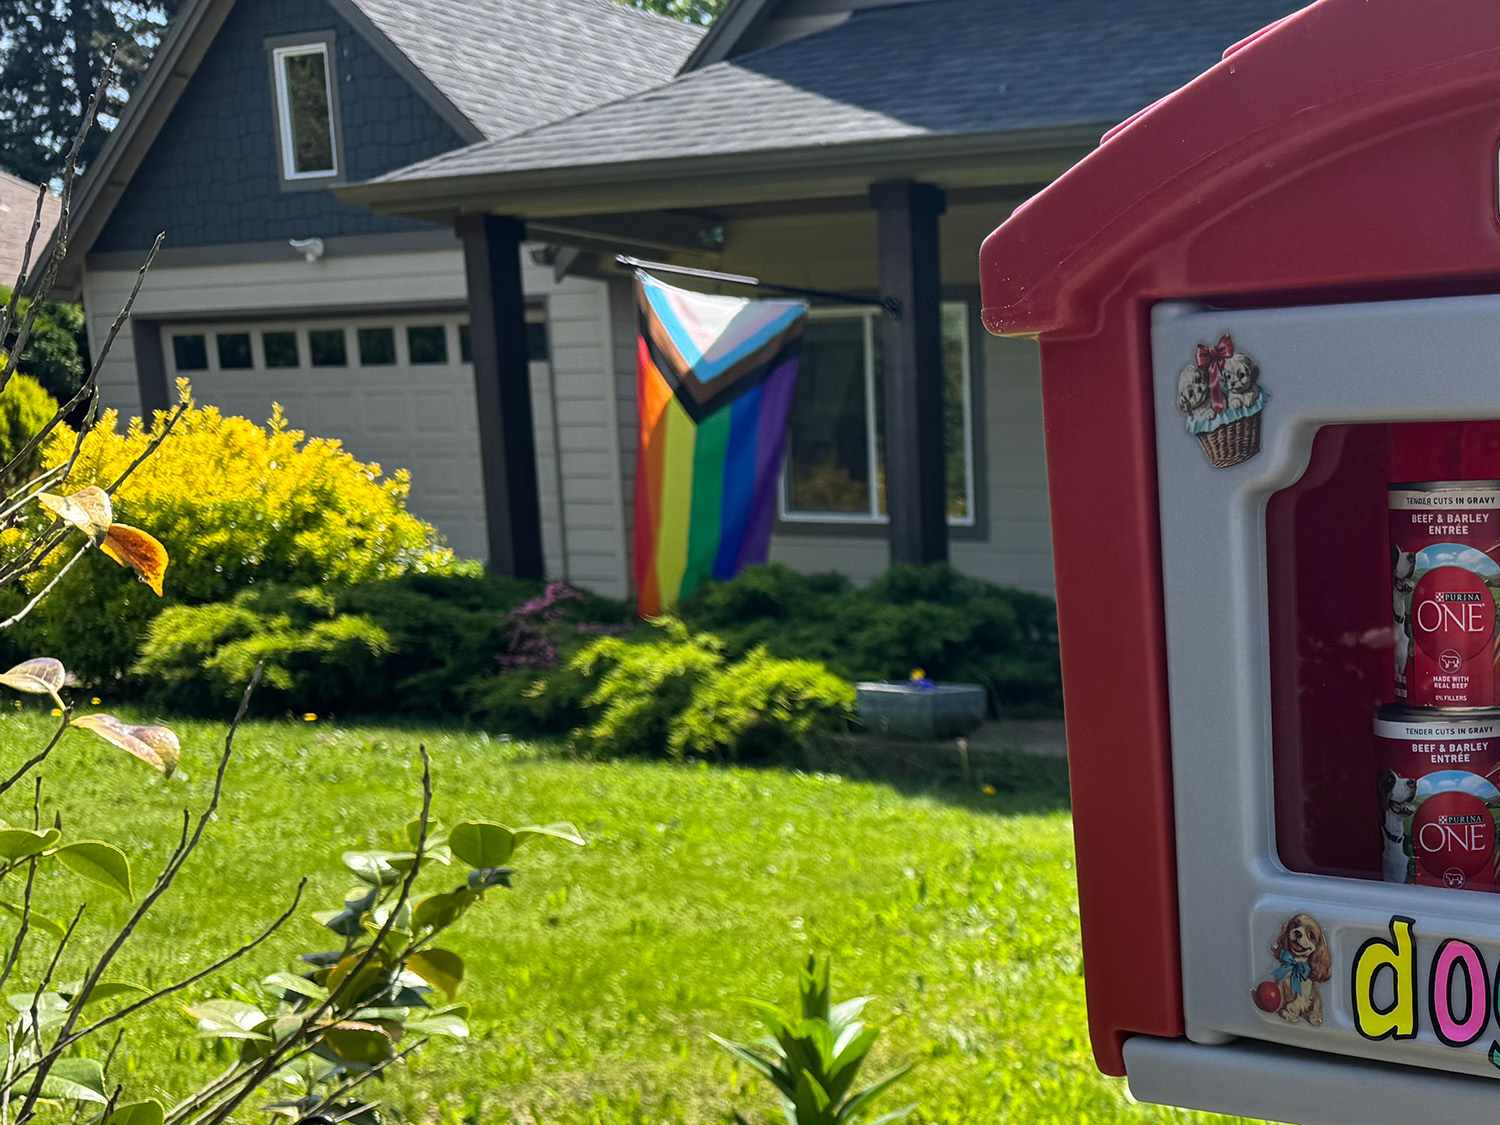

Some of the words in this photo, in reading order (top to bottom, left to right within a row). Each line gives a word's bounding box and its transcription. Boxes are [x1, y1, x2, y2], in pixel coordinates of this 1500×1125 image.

[1406, 497, 1432, 506] TENDER
[1433, 496, 1454, 505] CUTS
[1455, 496, 1465, 505] IN
[1466, 496, 1496, 504] GRAVY
[1411, 513, 1434, 524] BEEF
[1436, 514, 1445, 524] &
[1447, 513, 1489, 523] BARLEY
[1428, 523, 1469, 535] ENTRÉE
[1444, 593, 1481, 602] PURINA
[1417, 600, 1485, 632] ONE
[1405, 727, 1433, 736] TENDER
[1435, 727, 1456, 736] CUTS
[1457, 727, 1466, 735] IN
[1468, 726, 1494, 735] GRAVY
[1411, 743, 1436, 753] BEEF
[1439, 743, 1446, 753] &
[1449, 741, 1489, 753] BARLEY
[1431, 751, 1471, 764] ENTRÉE
[1448, 815, 1482, 824] PURINA
[1419, 822, 1486, 853] ONE
